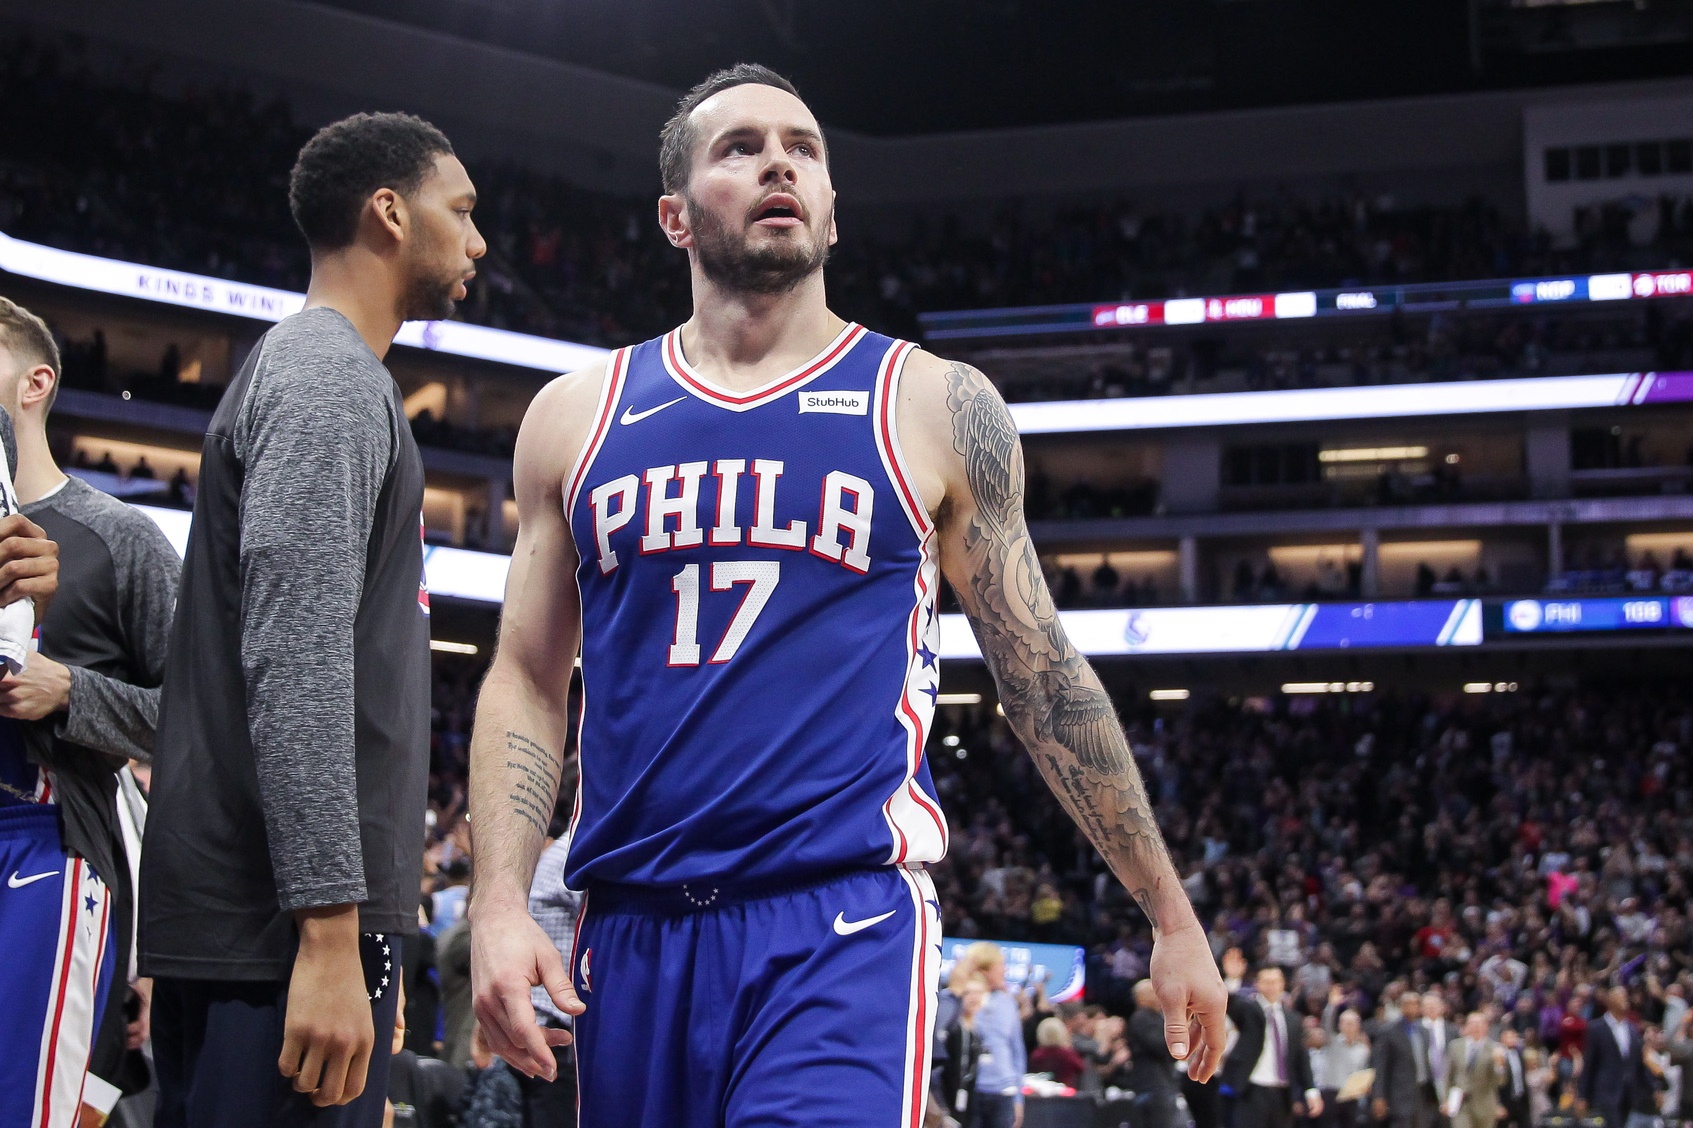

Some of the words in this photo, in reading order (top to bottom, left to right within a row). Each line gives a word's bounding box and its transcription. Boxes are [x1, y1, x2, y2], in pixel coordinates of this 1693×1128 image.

[138, 275, 214, 302] KINGS
[807, 397, 859, 408] StubHub
[588, 458, 875, 576] PHILA
[666, 560, 781, 668] 17
